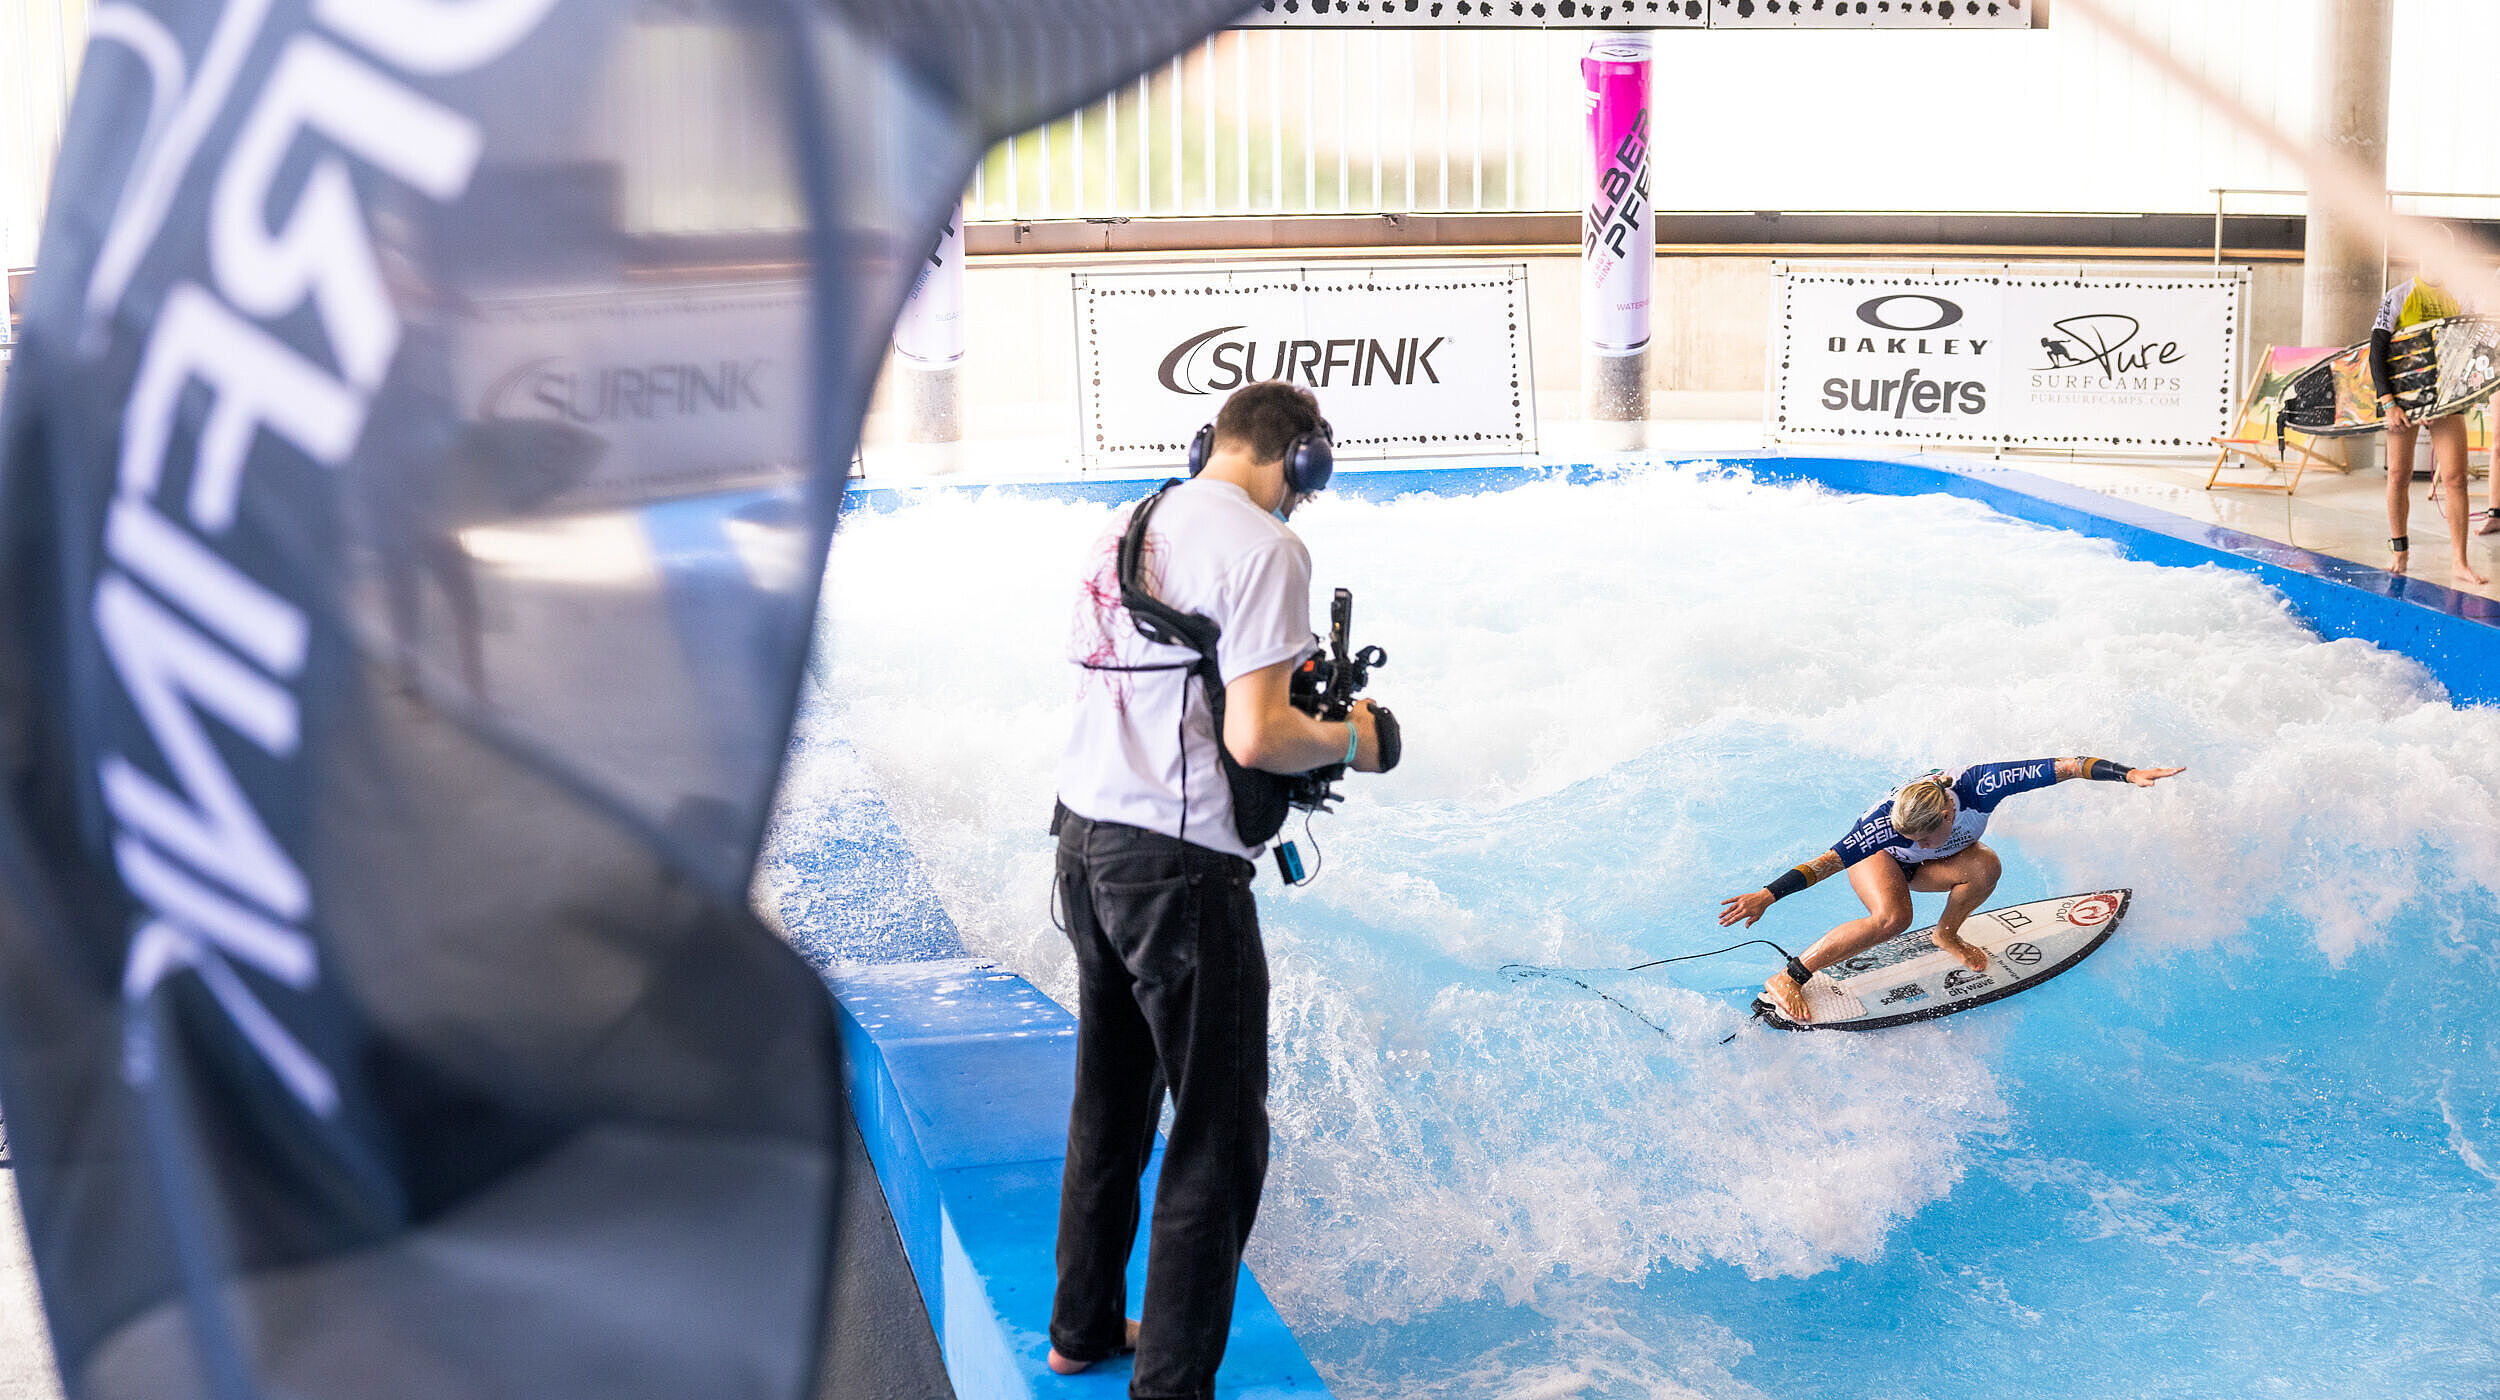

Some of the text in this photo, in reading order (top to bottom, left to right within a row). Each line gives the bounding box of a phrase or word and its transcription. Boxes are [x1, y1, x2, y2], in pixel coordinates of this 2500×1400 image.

[911, 268, 932, 301] DRINK
[1828, 336, 1988, 355] OAKLEY
[2051, 314, 2188, 380] Pure
[1208, 336, 1445, 391] SURFINK
[535, 360, 770, 423] SURFINK
[1822, 368, 1986, 419] surfers
[2031, 375, 2181, 391] SURFCAMPS
[1984, 763, 2045, 793] SURFINK
[1949, 976, 1995, 997] citywave
